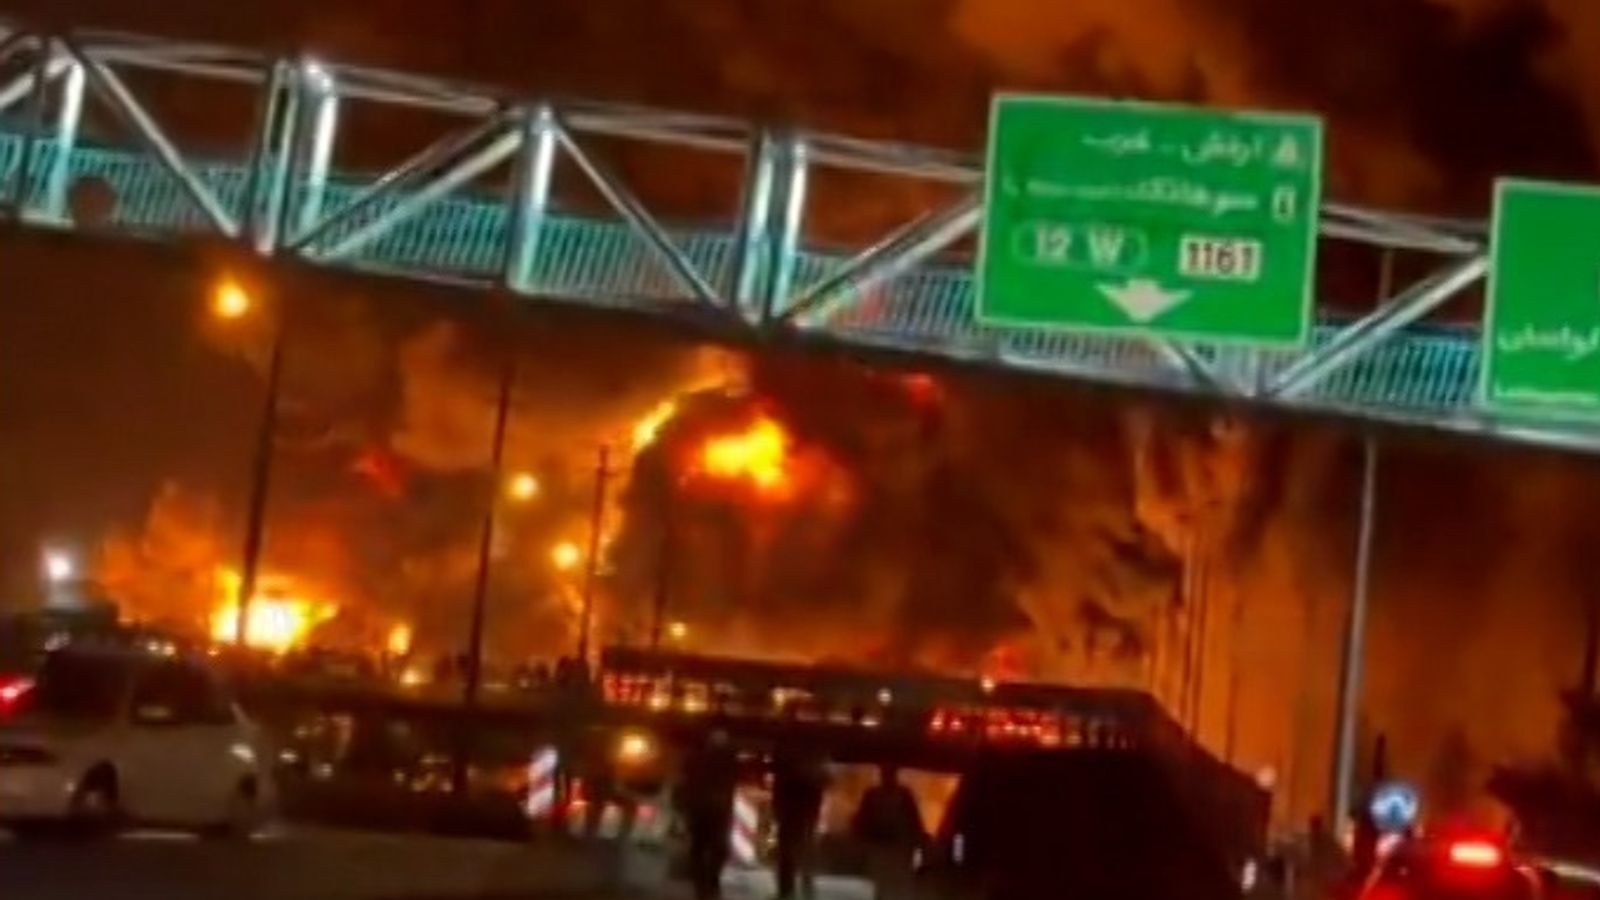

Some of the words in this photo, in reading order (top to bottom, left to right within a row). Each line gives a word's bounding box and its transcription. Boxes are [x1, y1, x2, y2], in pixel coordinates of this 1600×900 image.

[1036, 223, 1072, 261] 12
[1087, 225, 1125, 265] W
[1186, 241, 1254, 275] 1161
